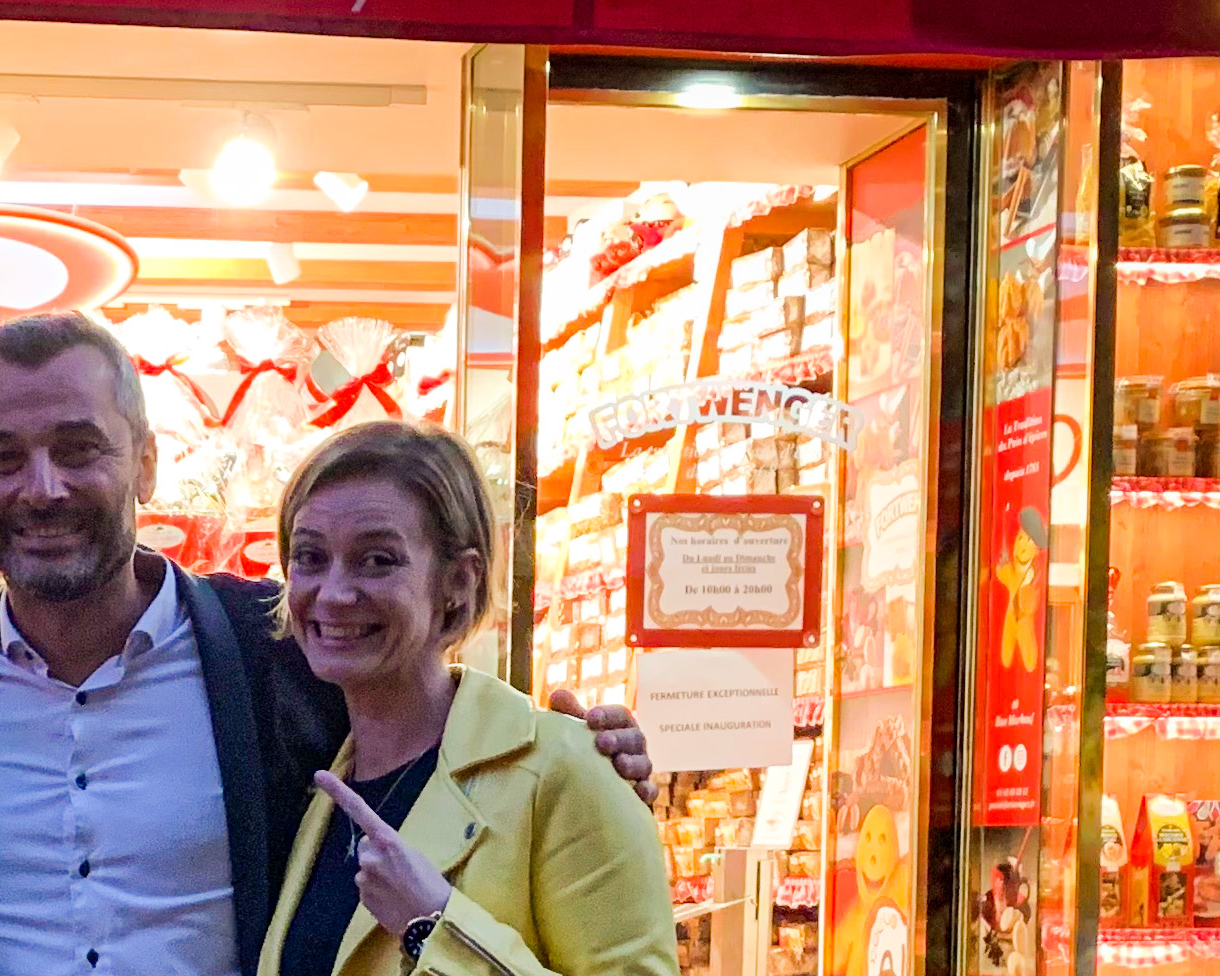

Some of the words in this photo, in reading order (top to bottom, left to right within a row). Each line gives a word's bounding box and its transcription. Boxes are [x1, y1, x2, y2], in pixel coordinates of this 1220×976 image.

[588, 380, 864, 451] FORTWENGER
[671, 536, 687, 545] Nos
[690, 536, 728, 545] horaires
[685, 585, 698, 594] De
[702, 585, 731, 594] 10h00
[743, 585, 773, 594] 20h00
[650, 690, 704, 701] FERMETURE
[707, 688, 779, 698] EXCEPTIONNELLE
[659, 723, 700, 733] SPECIALE
[703, 720, 771, 730] INAUGURATION
